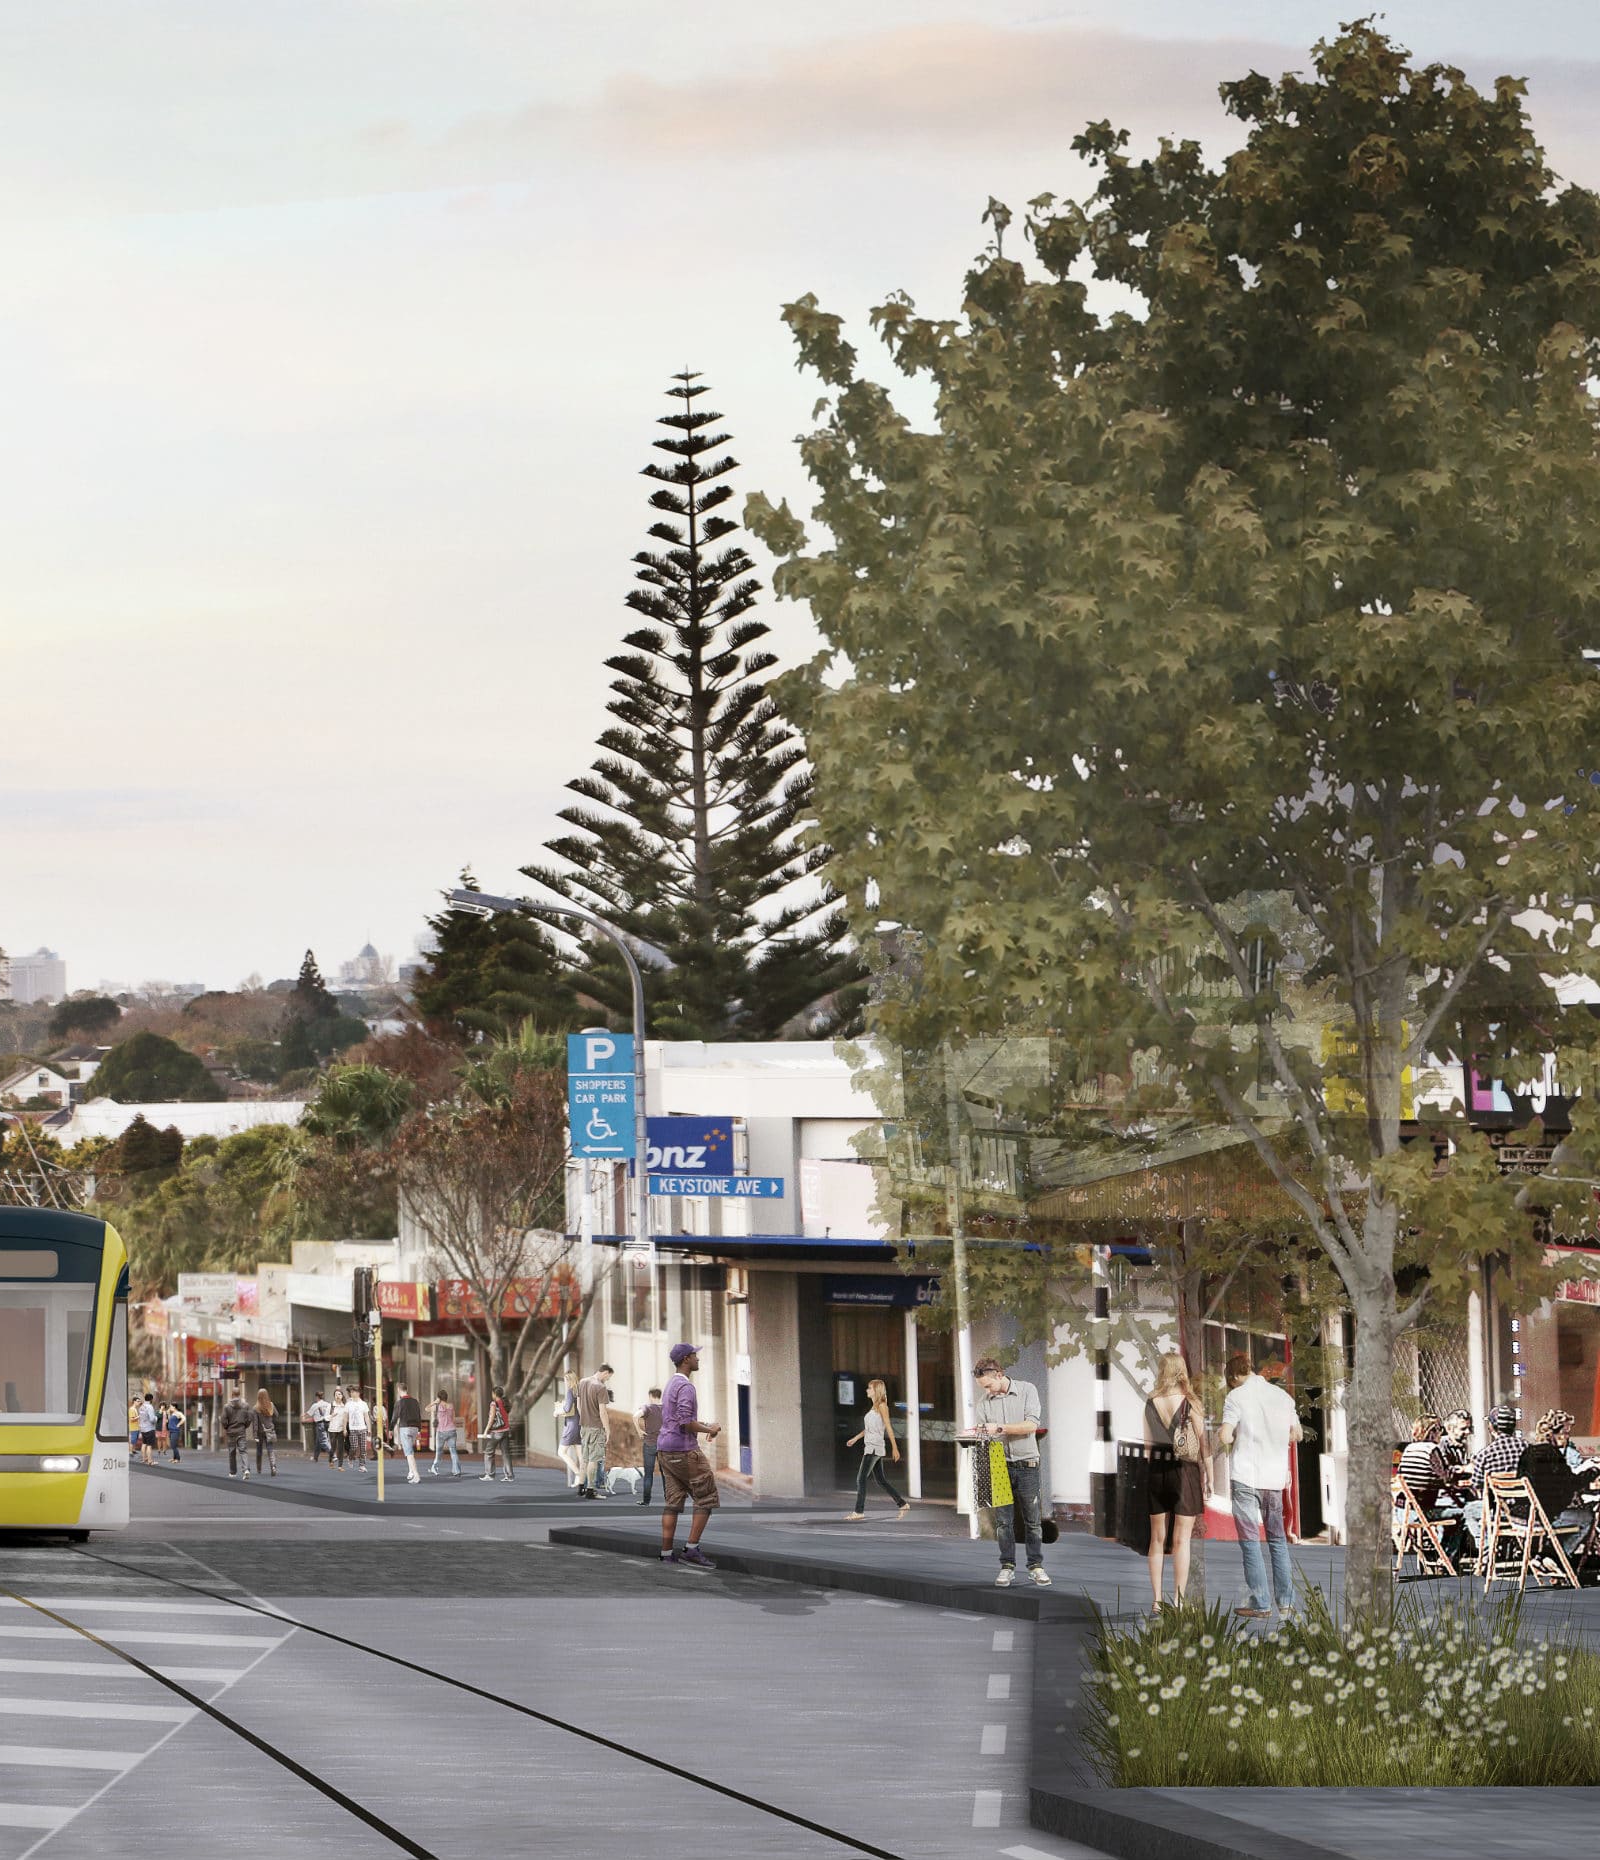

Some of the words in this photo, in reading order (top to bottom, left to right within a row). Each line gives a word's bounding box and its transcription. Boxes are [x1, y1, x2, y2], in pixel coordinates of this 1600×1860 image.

[586, 1038, 616, 1070] P
[575, 1080, 627, 1090] SHOPPERS
[575, 1094, 596, 1104] CAR
[601, 1094, 627, 1104] PARK
[646, 1138, 707, 1169] bnz
[659, 1179, 730, 1194] KEYSTONE
[735, 1180, 762, 1195] AVE
[103, 1458, 118, 1470] 201
